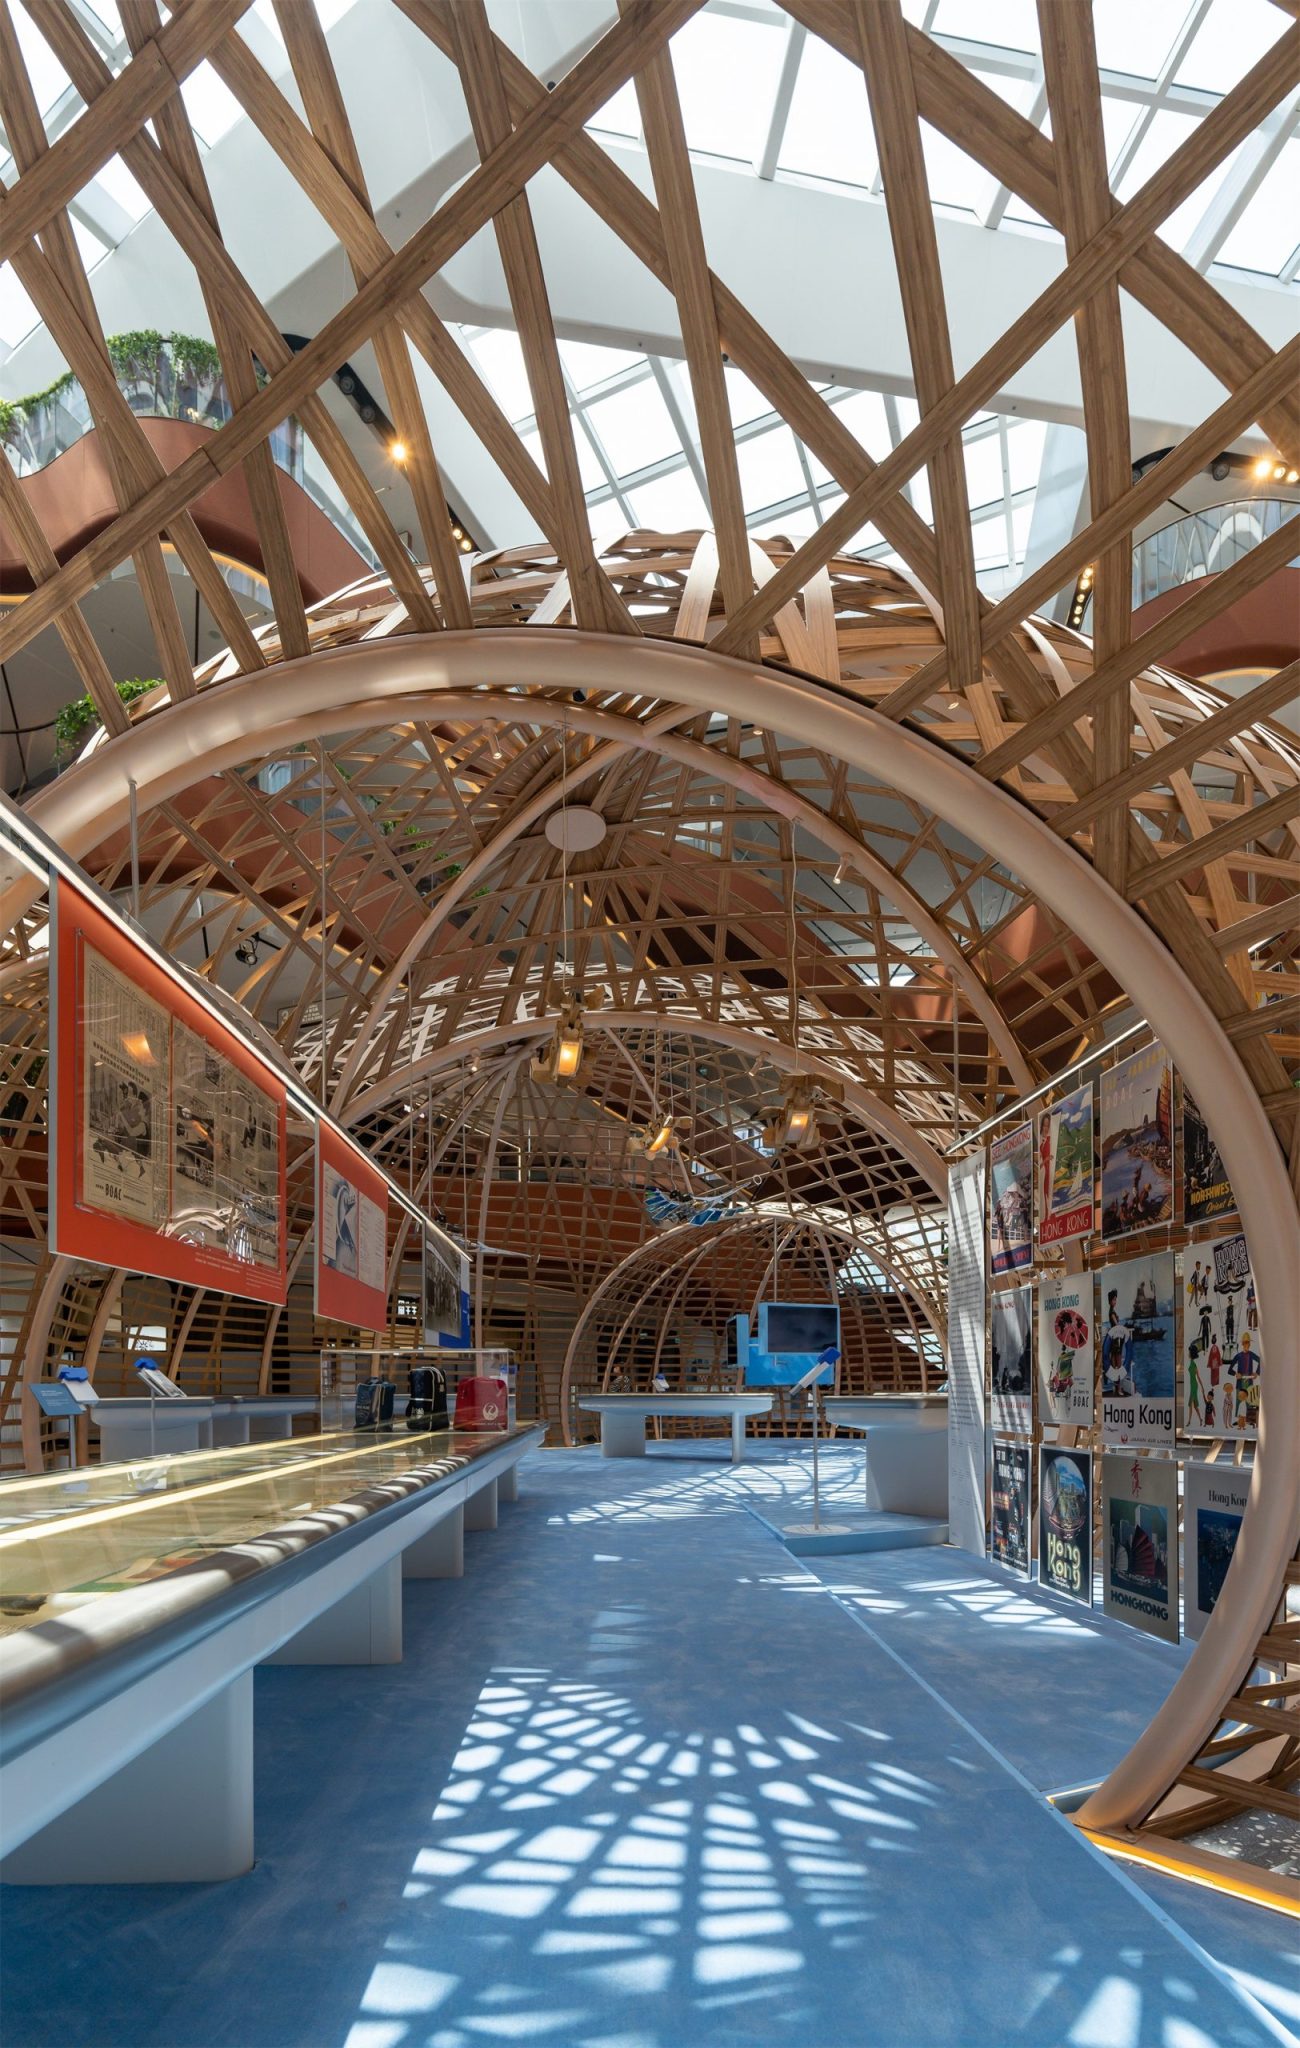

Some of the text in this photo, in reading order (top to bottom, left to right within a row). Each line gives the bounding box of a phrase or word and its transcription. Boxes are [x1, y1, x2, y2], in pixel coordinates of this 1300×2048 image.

[105, 1183, 122, 1201] BOAC
[1042, 1221, 1063, 1242] HONG
[1066, 1212, 1089, 1232] KONG
[1215, 1239, 1247, 1266] HONG
[1044, 1294, 1080, 1312] HONG KONG
[1073, 1396, 1090, 1408] BOAC
[1103, 1403, 1172, 1431] Hong Kong
[1208, 1489, 1247, 1507] Hong Kon
[1047, 1532, 1081, 1570] Hong
[1047, 1552, 1081, 1591] Kong
[1110, 1589, 1169, 1621] HONGKONG
